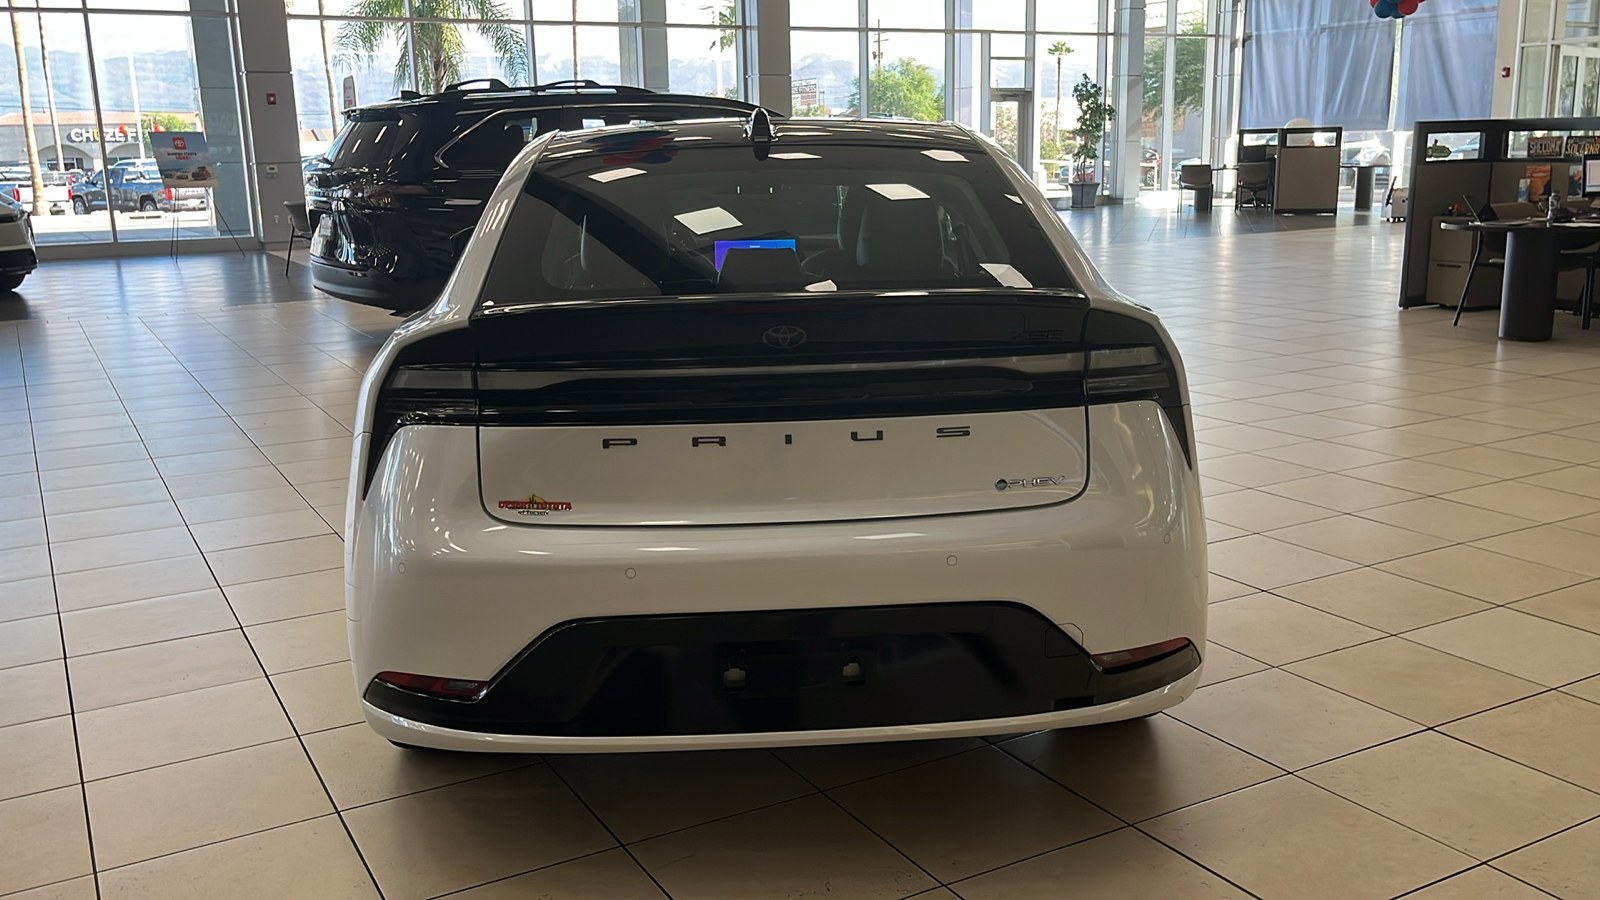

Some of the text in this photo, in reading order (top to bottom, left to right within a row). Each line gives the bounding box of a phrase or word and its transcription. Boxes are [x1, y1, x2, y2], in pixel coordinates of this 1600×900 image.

[1010, 329, 1065, 341] XSE
[602, 426, 971, 449] PRIUS
[1007, 475, 1065, 488] PHEV
